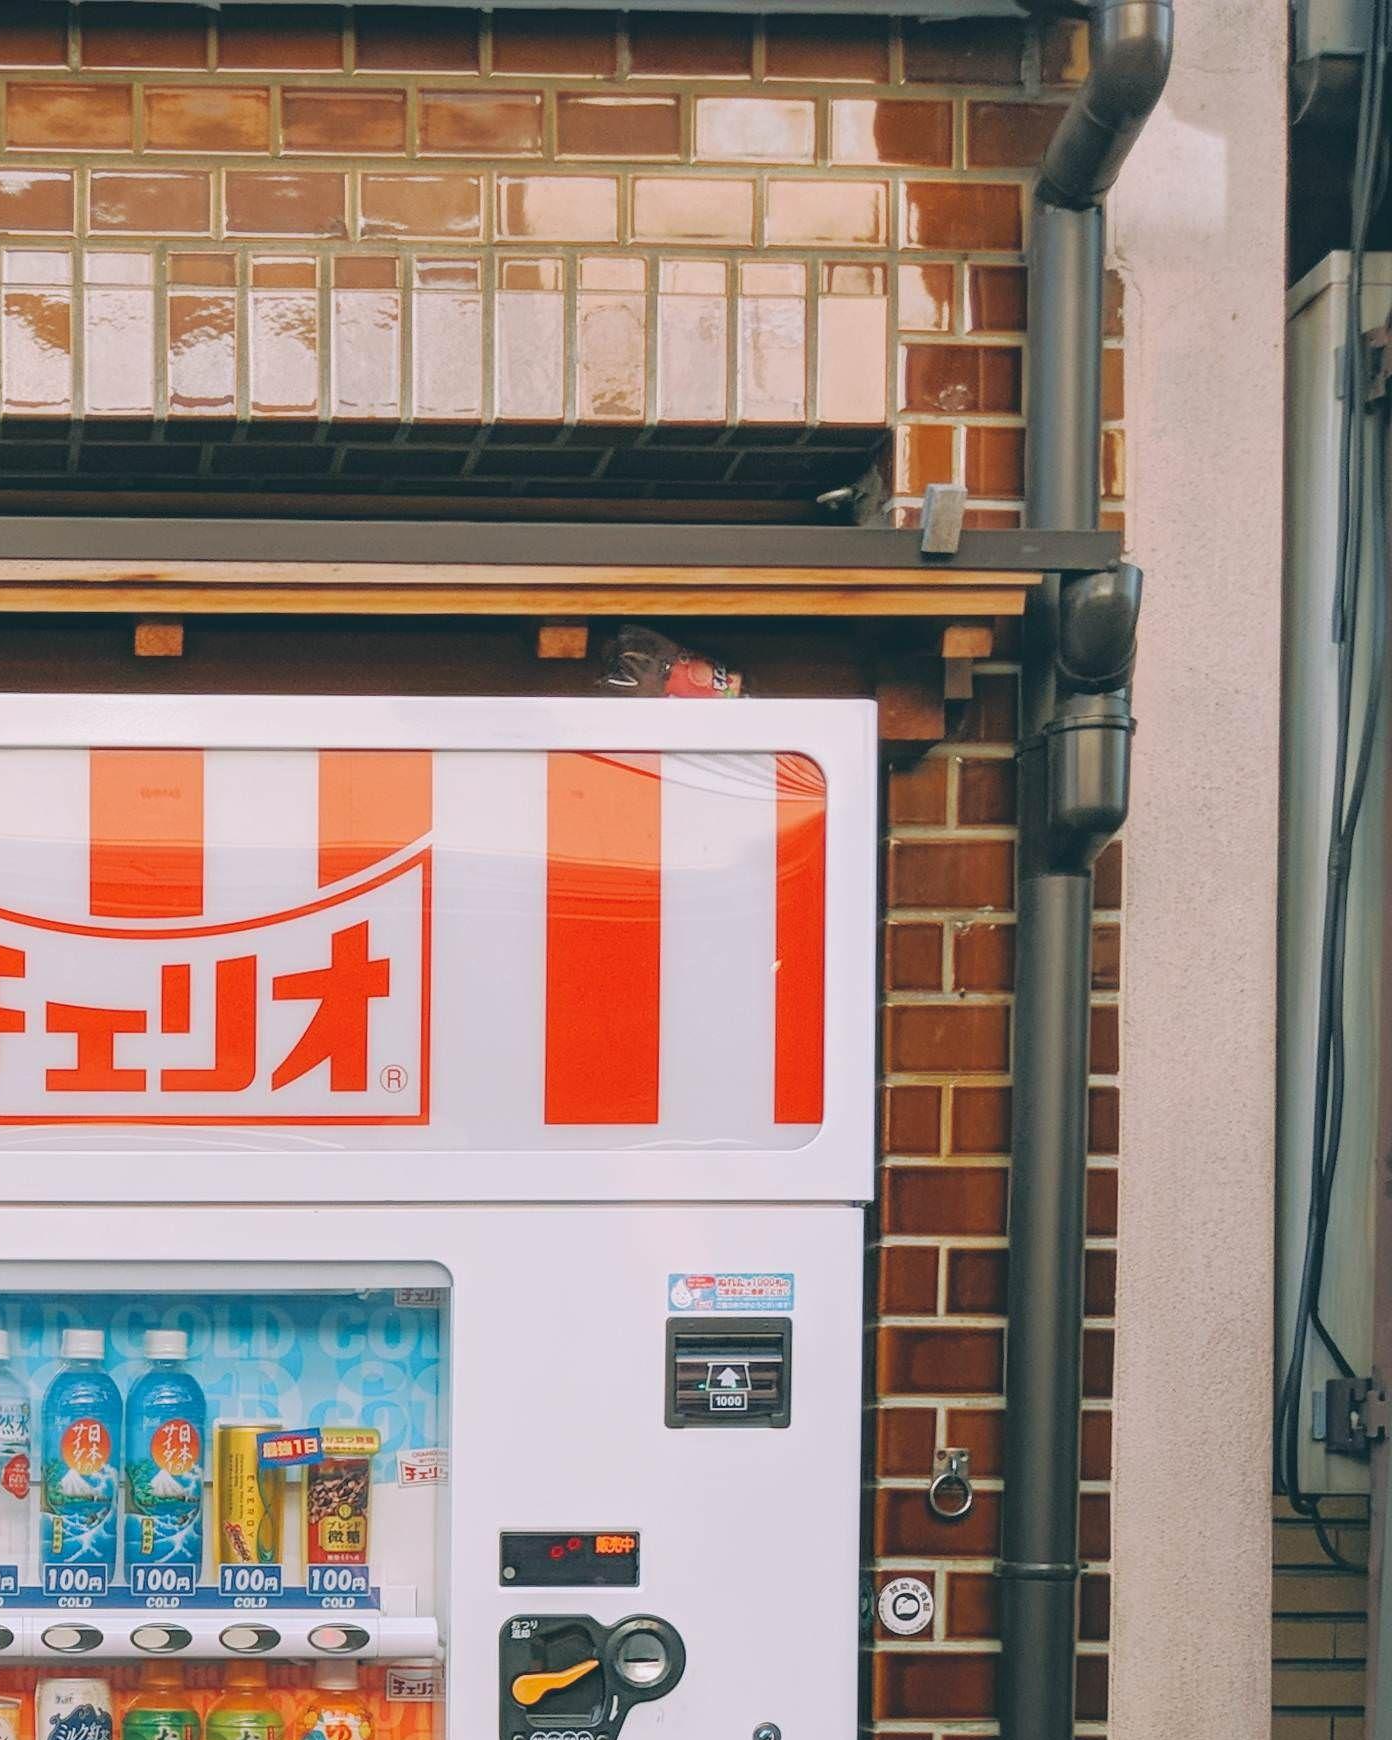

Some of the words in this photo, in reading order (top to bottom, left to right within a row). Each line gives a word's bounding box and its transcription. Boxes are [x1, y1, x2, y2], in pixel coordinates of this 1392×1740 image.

[714, 1396, 742, 1407] 1000
[595, 1535, 636, 1554] 販売中
[48, 1568, 102, 1592] 100円
[136, 1568, 191, 1592] 100円
[223, 1568, 278, 1593] 100円
[312, 1568, 367, 1593] 100円
[58, 1597, 92, 1609] COLD
[146, 1597, 180, 1609] COLD
[234, 1597, 267, 1609] COLD
[322, 1597, 355, 1609] COLD
